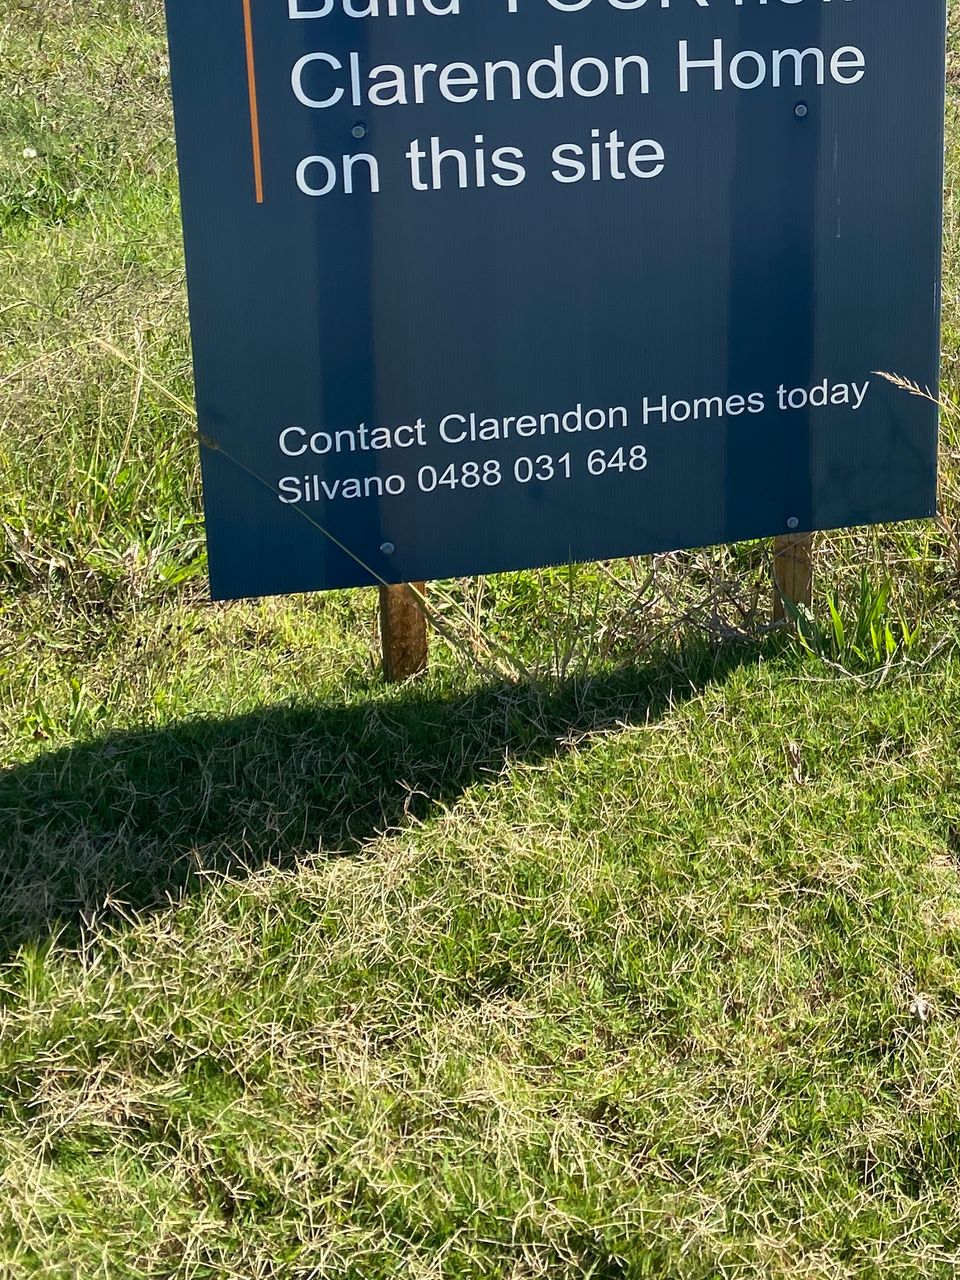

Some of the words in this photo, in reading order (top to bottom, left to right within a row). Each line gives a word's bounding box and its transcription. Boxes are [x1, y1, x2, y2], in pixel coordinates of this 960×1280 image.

[291, 45, 649, 109] Clarendon
[678, 38, 866, 92] Home
[295, 152, 380, 197] on
[405, 134, 526, 191] this
[551, 128, 665, 183] site
[278, 417, 427, 457] Contact
[438, 403, 629, 444] Clarendon
[642, 392, 765, 425] Homes
[776, 378, 870, 410] today
[278, 473, 406, 504] Silvano
[417, 459, 502, 493] 0488
[513, 451, 571, 483] 031
[587, 444, 649, 476] 648
